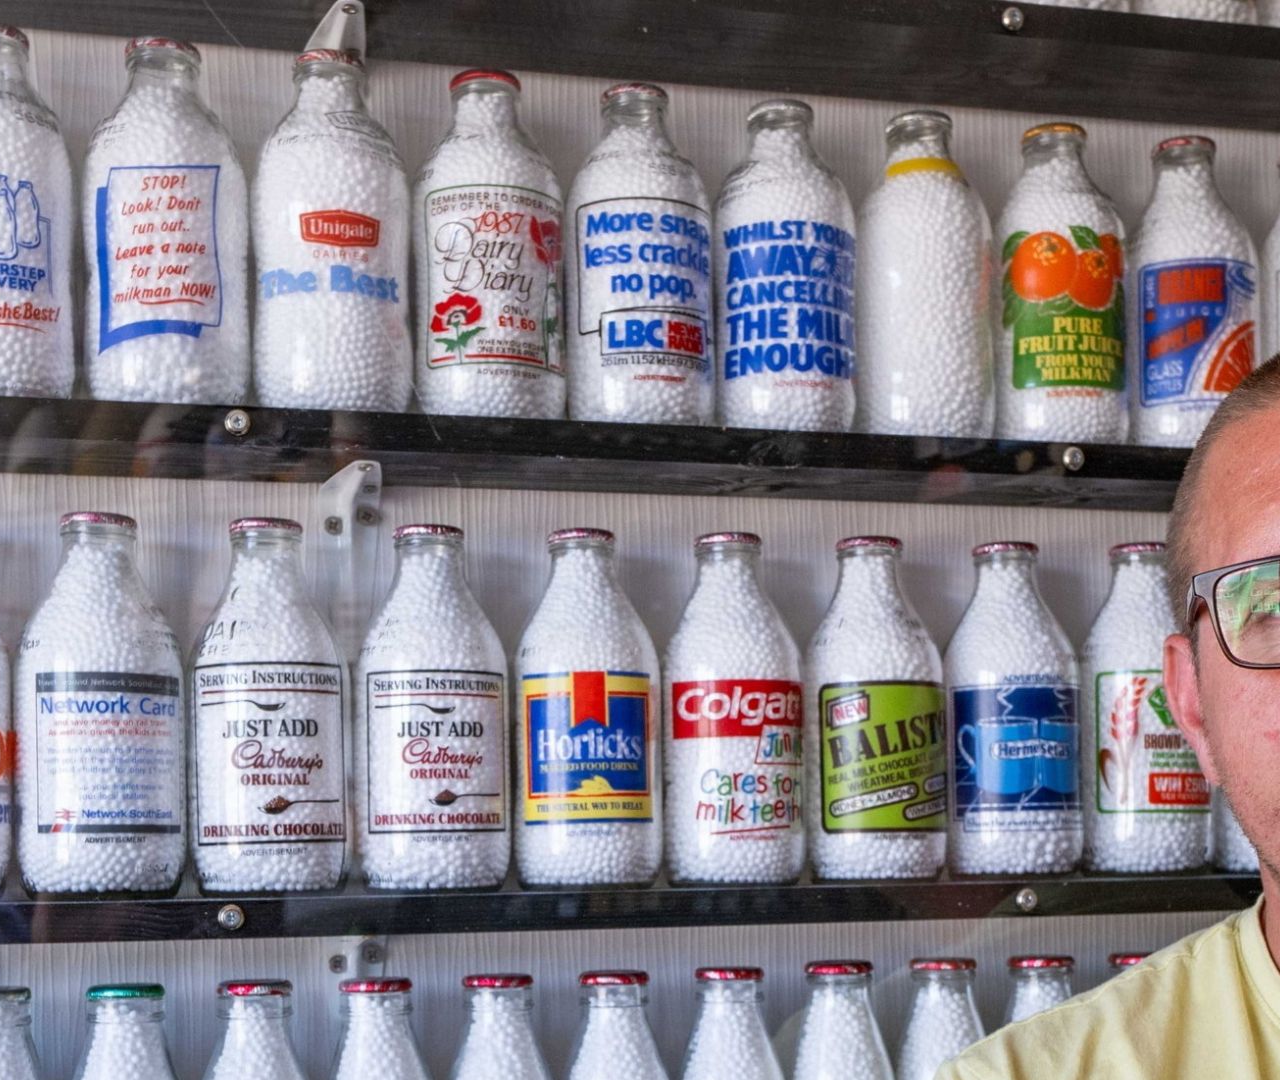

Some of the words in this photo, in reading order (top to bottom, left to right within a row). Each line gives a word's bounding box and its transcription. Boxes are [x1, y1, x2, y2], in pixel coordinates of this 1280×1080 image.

[120, 197, 162, 217] Look!
[166, 195, 201, 212] Don't
[307, 217, 374, 242] Unigate
[474, 211, 526, 236] 1987
[129, 263, 153, 281] for
[156, 262, 191, 281] your
[112, 284, 172, 306] milkman
[179, 282, 217, 300] NOW!
[260, 266, 318, 300] The
[329, 264, 400, 305] Best
[607, 319, 665, 349] LBC
[667, 321, 703, 340] NEWS
[1052, 316, 1103, 337] PURE
[1040, 365, 1113, 384] MILKMAN
[1146, 361, 1184, 381] GLASS
[199, 671, 251, 688] SERVING
[251, 669, 339, 688] INSTRUCTIONS
[40, 695, 131, 716] Network
[139, 697, 177, 718] Card
[833, 699, 869, 721] NEW
[396, 721, 445, 740] JUST
[446, 721, 484, 739] ADD
[536, 728, 642, 764] Horlicks
[997, 741, 1072, 758] Hermesetas
[1143, 733, 1183, 750] BROWN
[230, 739, 324, 774] Cadbury's
[401, 737, 484, 770] Cadbury's
[239, 773, 311, 787] ORIGINAL
[409, 767, 472, 780] ORIGINAL
[373, 813, 436, 827] DRINKING
[438, 812, 502, 826] CHOCOLATE
[695, 798, 746, 825] milk
[748, 797, 801, 825] teeth
[202, 824, 270, 839] DRINKING
[272, 822, 345, 838] CHOCOLATE
